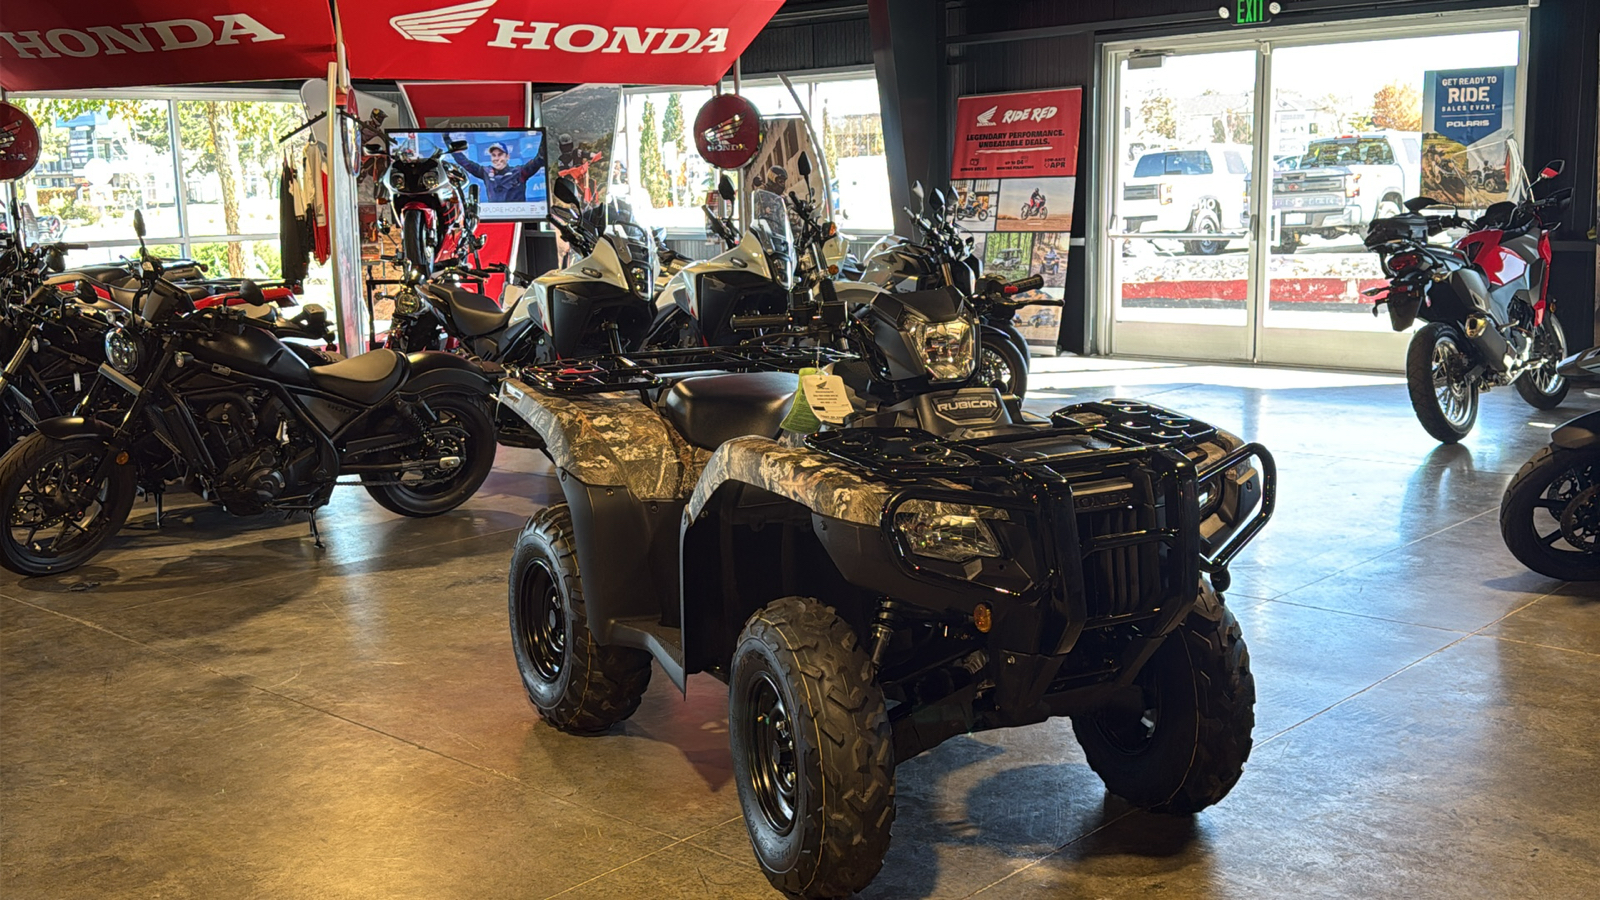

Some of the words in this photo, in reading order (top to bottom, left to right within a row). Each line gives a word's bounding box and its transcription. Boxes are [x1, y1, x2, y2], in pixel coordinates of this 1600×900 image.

[1237, 0, 1264, 23] EXIT
[0, 13, 286, 59] HONDA
[487, 18, 730, 54] HONDA
[1442, 78, 1458, 86] GET
[1459, 77, 1485, 85] READY
[1487, 76, 1497, 84] TO
[1448, 86, 1490, 104] RIDE
[1002, 108, 1031, 124] RIDE
[1031, 106, 1058, 123] RED
[1446, 120, 1490, 128] POLARIS
[966, 132, 1007, 141] LEGENDARY
[1009, 130, 1065, 139] PERFORMANCE.
[707, 143, 749, 152] HONDA
[978, 139, 1024, 148] UNBEATABLE
[1025, 138, 1050, 147] DEALS.
[505, 206, 526, 214] HONDA
[937, 400, 998, 412] RUBICON
